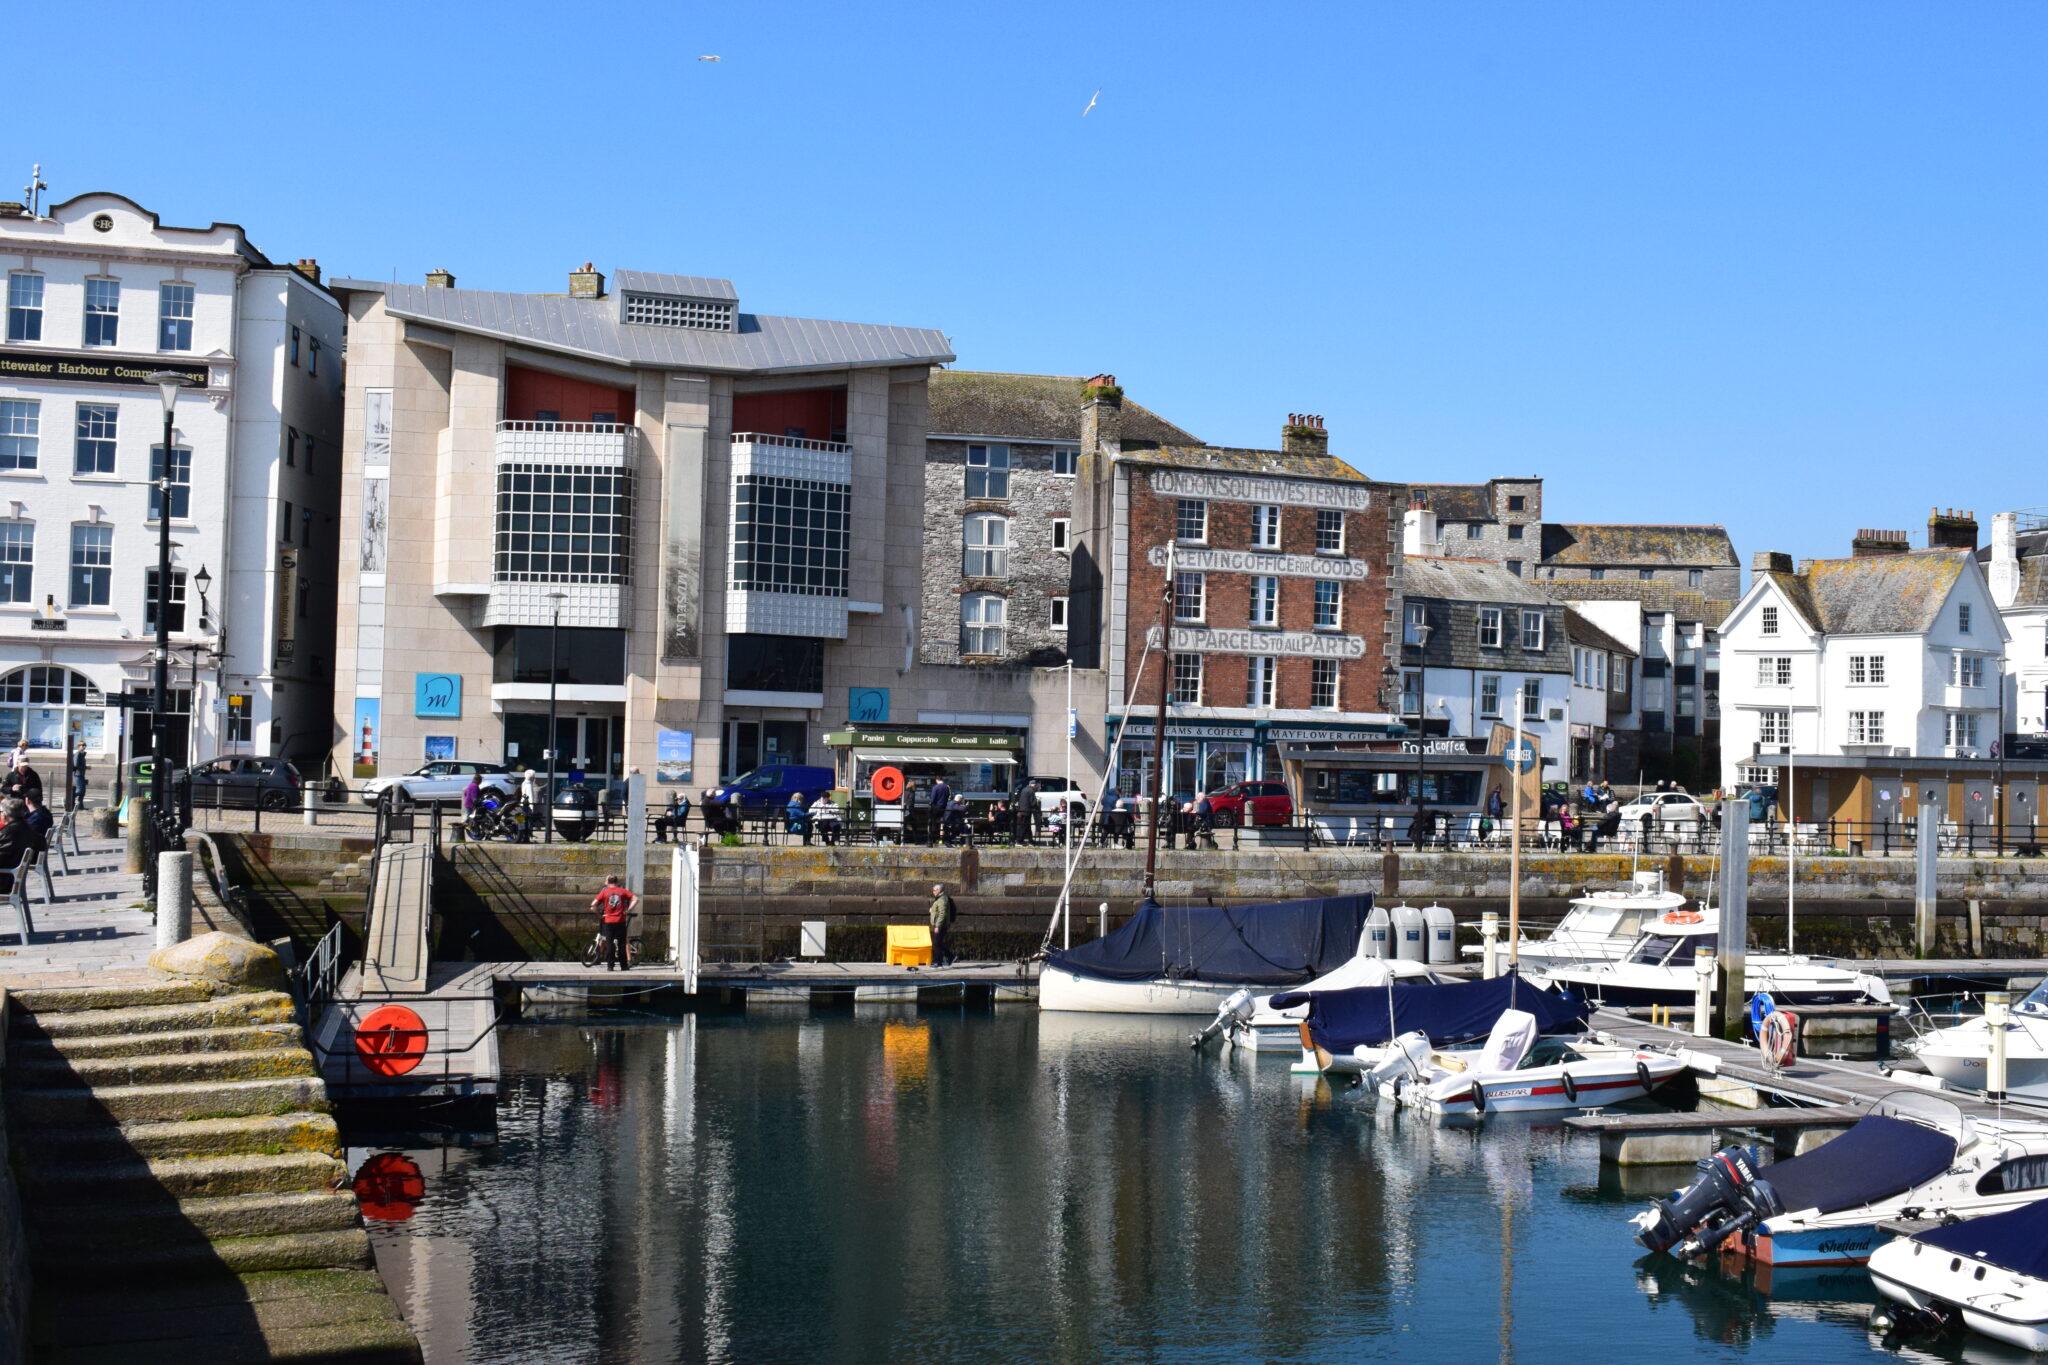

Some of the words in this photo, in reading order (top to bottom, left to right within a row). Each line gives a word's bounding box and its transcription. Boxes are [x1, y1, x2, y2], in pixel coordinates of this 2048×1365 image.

[58, 363, 110, 376] Harbour
[1154, 547, 1243, 570] RCEIVING
[1245, 553, 1294, 573] OFFICE
[1295, 560, 1310, 573] FOR
[1311, 558, 1364, 577] GOODS
[676, 568, 688, 638] MUSEUM
[1194, 629, 1268, 651] PARCELS
[1270, 638, 1281, 649] TO
[1284, 638, 1301, 651] ALL
[1301, 634, 1360, 655] PARTS
[1130, 725, 1146, 734] ICE
[1152, 726, 1191, 735] CEAMS
[1196, 727, 1203, 735] &
[1207, 727, 1245, 736] COFFEE
[1271, 729, 1343, 740] MAYFLOWER
[862, 734, 885, 742] Panini
[896, 735, 939, 744] Cappuccino
[951, 736, 978, 744] Cannoli
[989, 737, 1008, 745] Latte
[1435, 740, 1465, 754] coffee
[1823, 1238, 1871, 1253] Shetland
